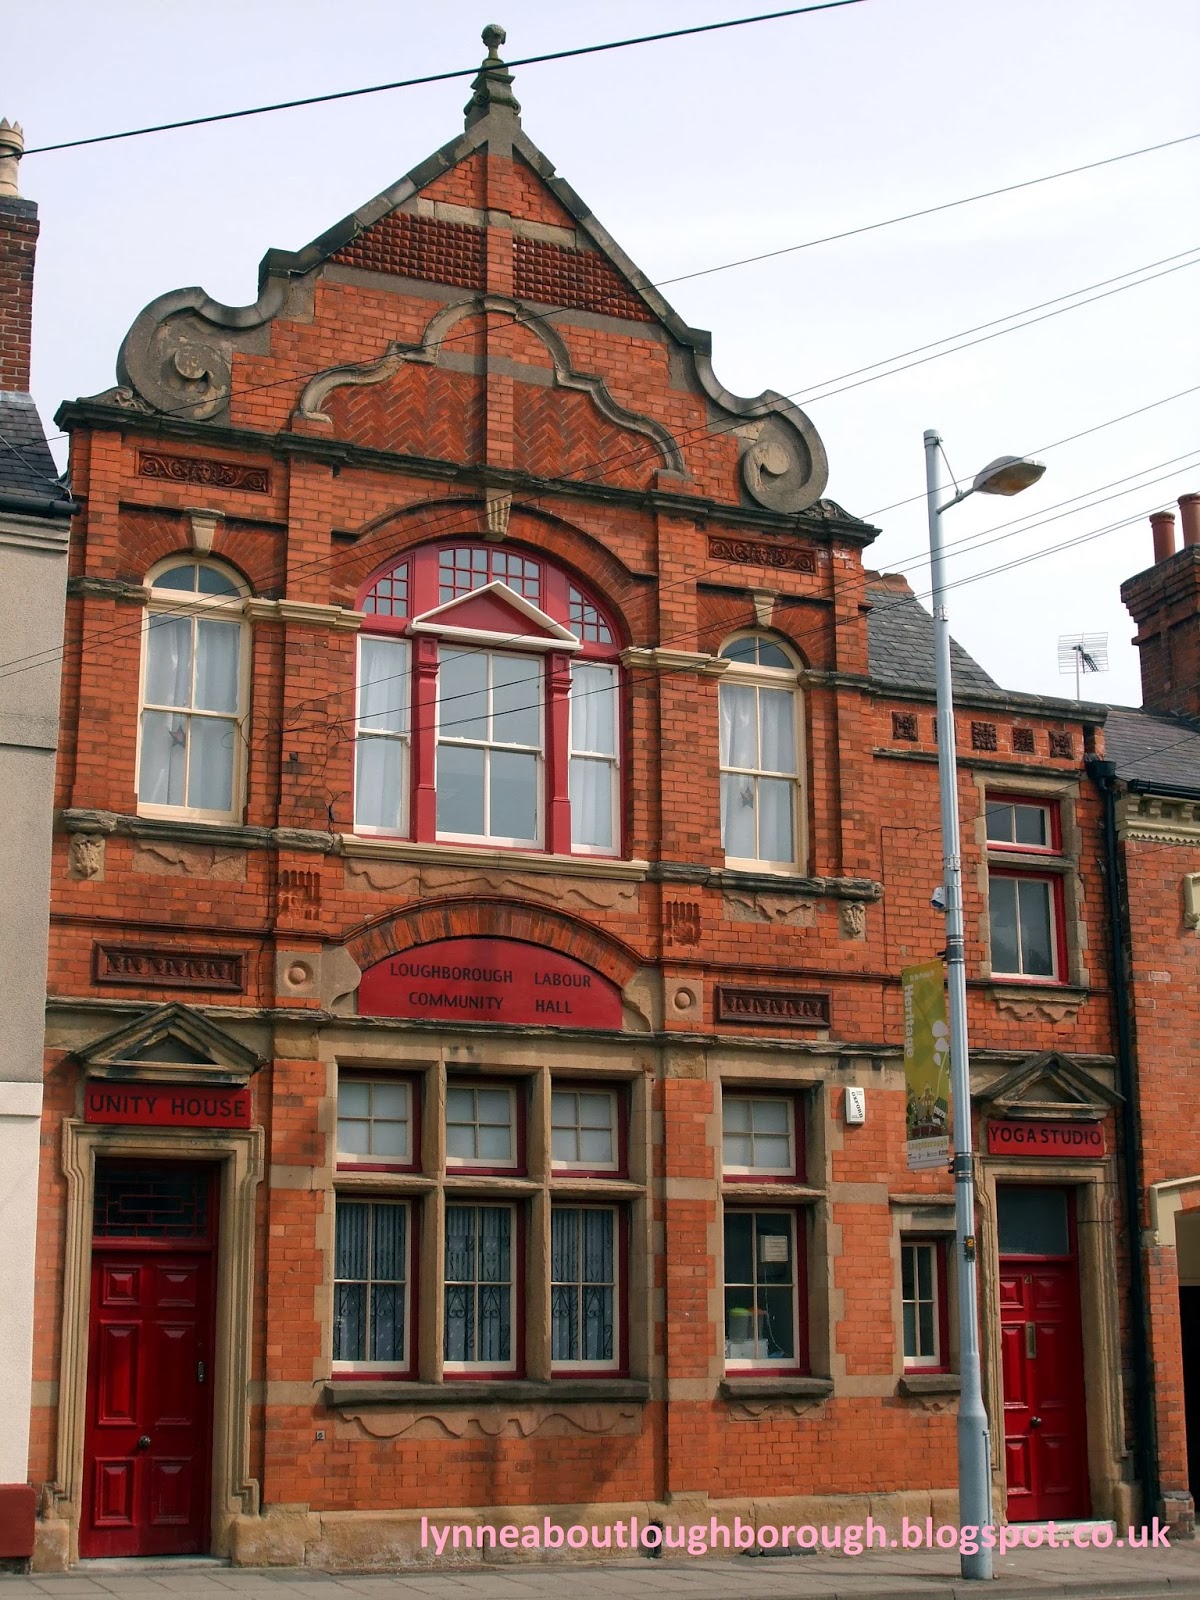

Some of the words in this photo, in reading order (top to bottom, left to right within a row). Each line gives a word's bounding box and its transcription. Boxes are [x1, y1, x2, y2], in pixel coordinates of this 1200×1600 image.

[390, 962, 512, 983] LOUGHBOROUGH
[534, 972, 591, 988] LABOUR
[408, 991, 504, 1010] COMMUNITY
[535, 1000, 573, 1014] HALL
[904, 984, 914, 1058] Heritage
[89, 1095, 157, 1114] UNITY
[171, 1099, 246, 1118] HOUSE
[990, 1127, 1037, 1143] YOGA
[1040, 1129, 1101, 1146] STUDIO
